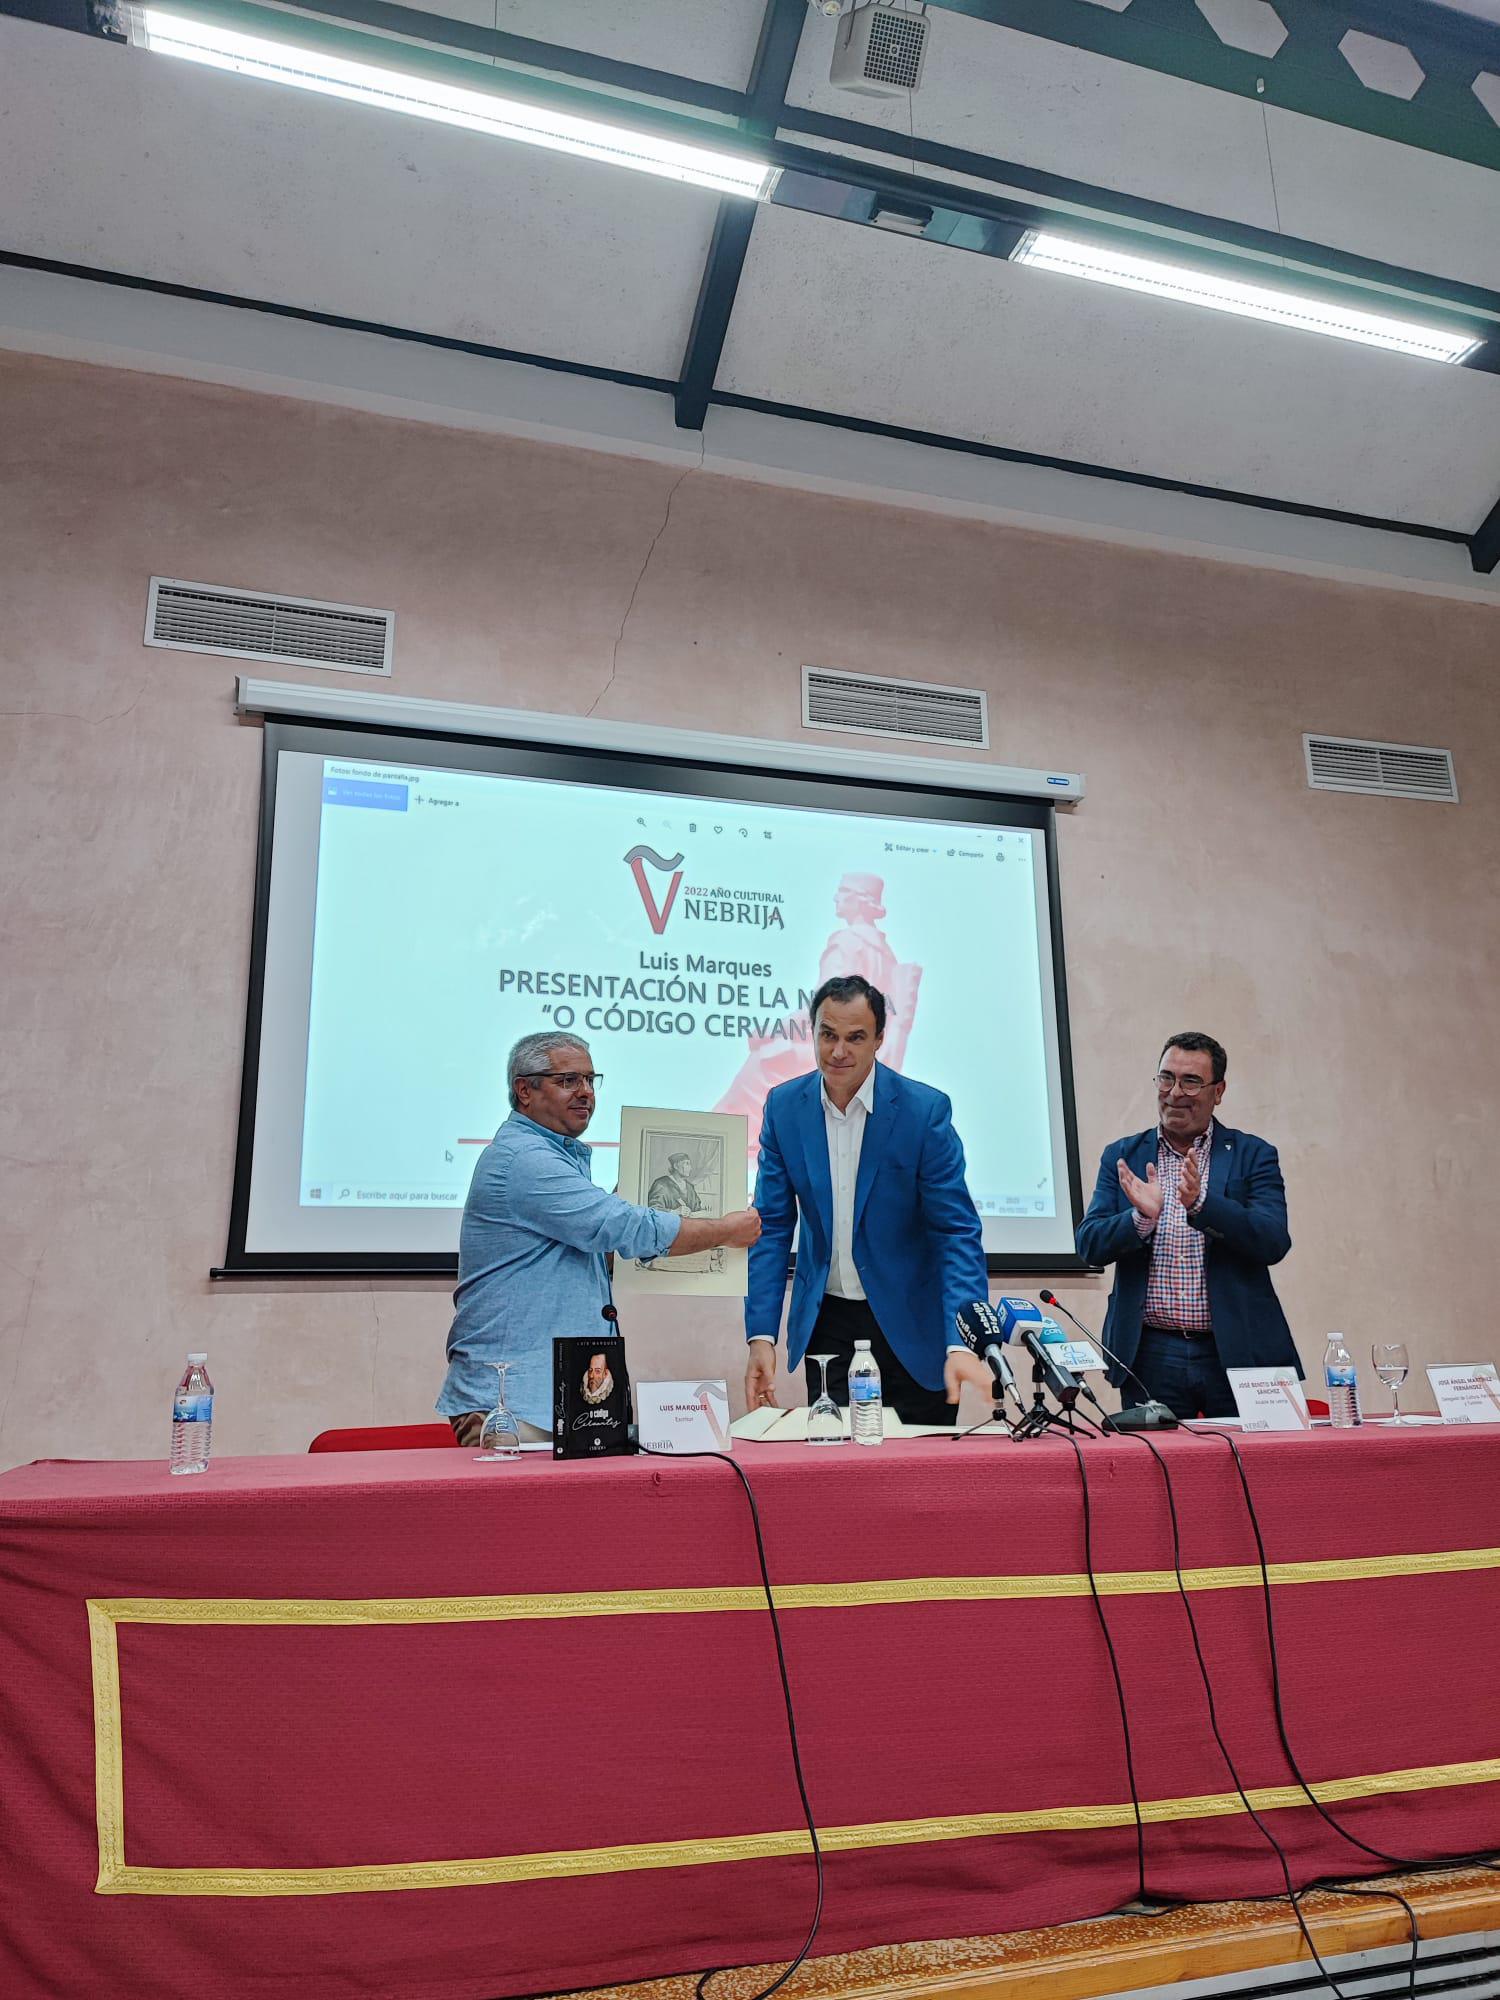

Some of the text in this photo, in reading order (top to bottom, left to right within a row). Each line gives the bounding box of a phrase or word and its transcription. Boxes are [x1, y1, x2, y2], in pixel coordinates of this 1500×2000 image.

[428, 797, 453, 807] Agregar
[684, 886, 785, 904] 2022 AÑO CULTURAL
[684, 898, 785, 930] NEBRIJA
[640, 951, 772, 980] Luis Marques
[499, 969, 707, 1005] PRESENTACIÓN
[717, 983, 750, 1008] DE
[759, 986, 790, 1010] LA
[585, 1002, 696, 1036] CÓDIGO
[356, 1190, 458, 1202] Escribe aquí para buscar
[659, 1404, 708, 1412] LUIS MARQUES
